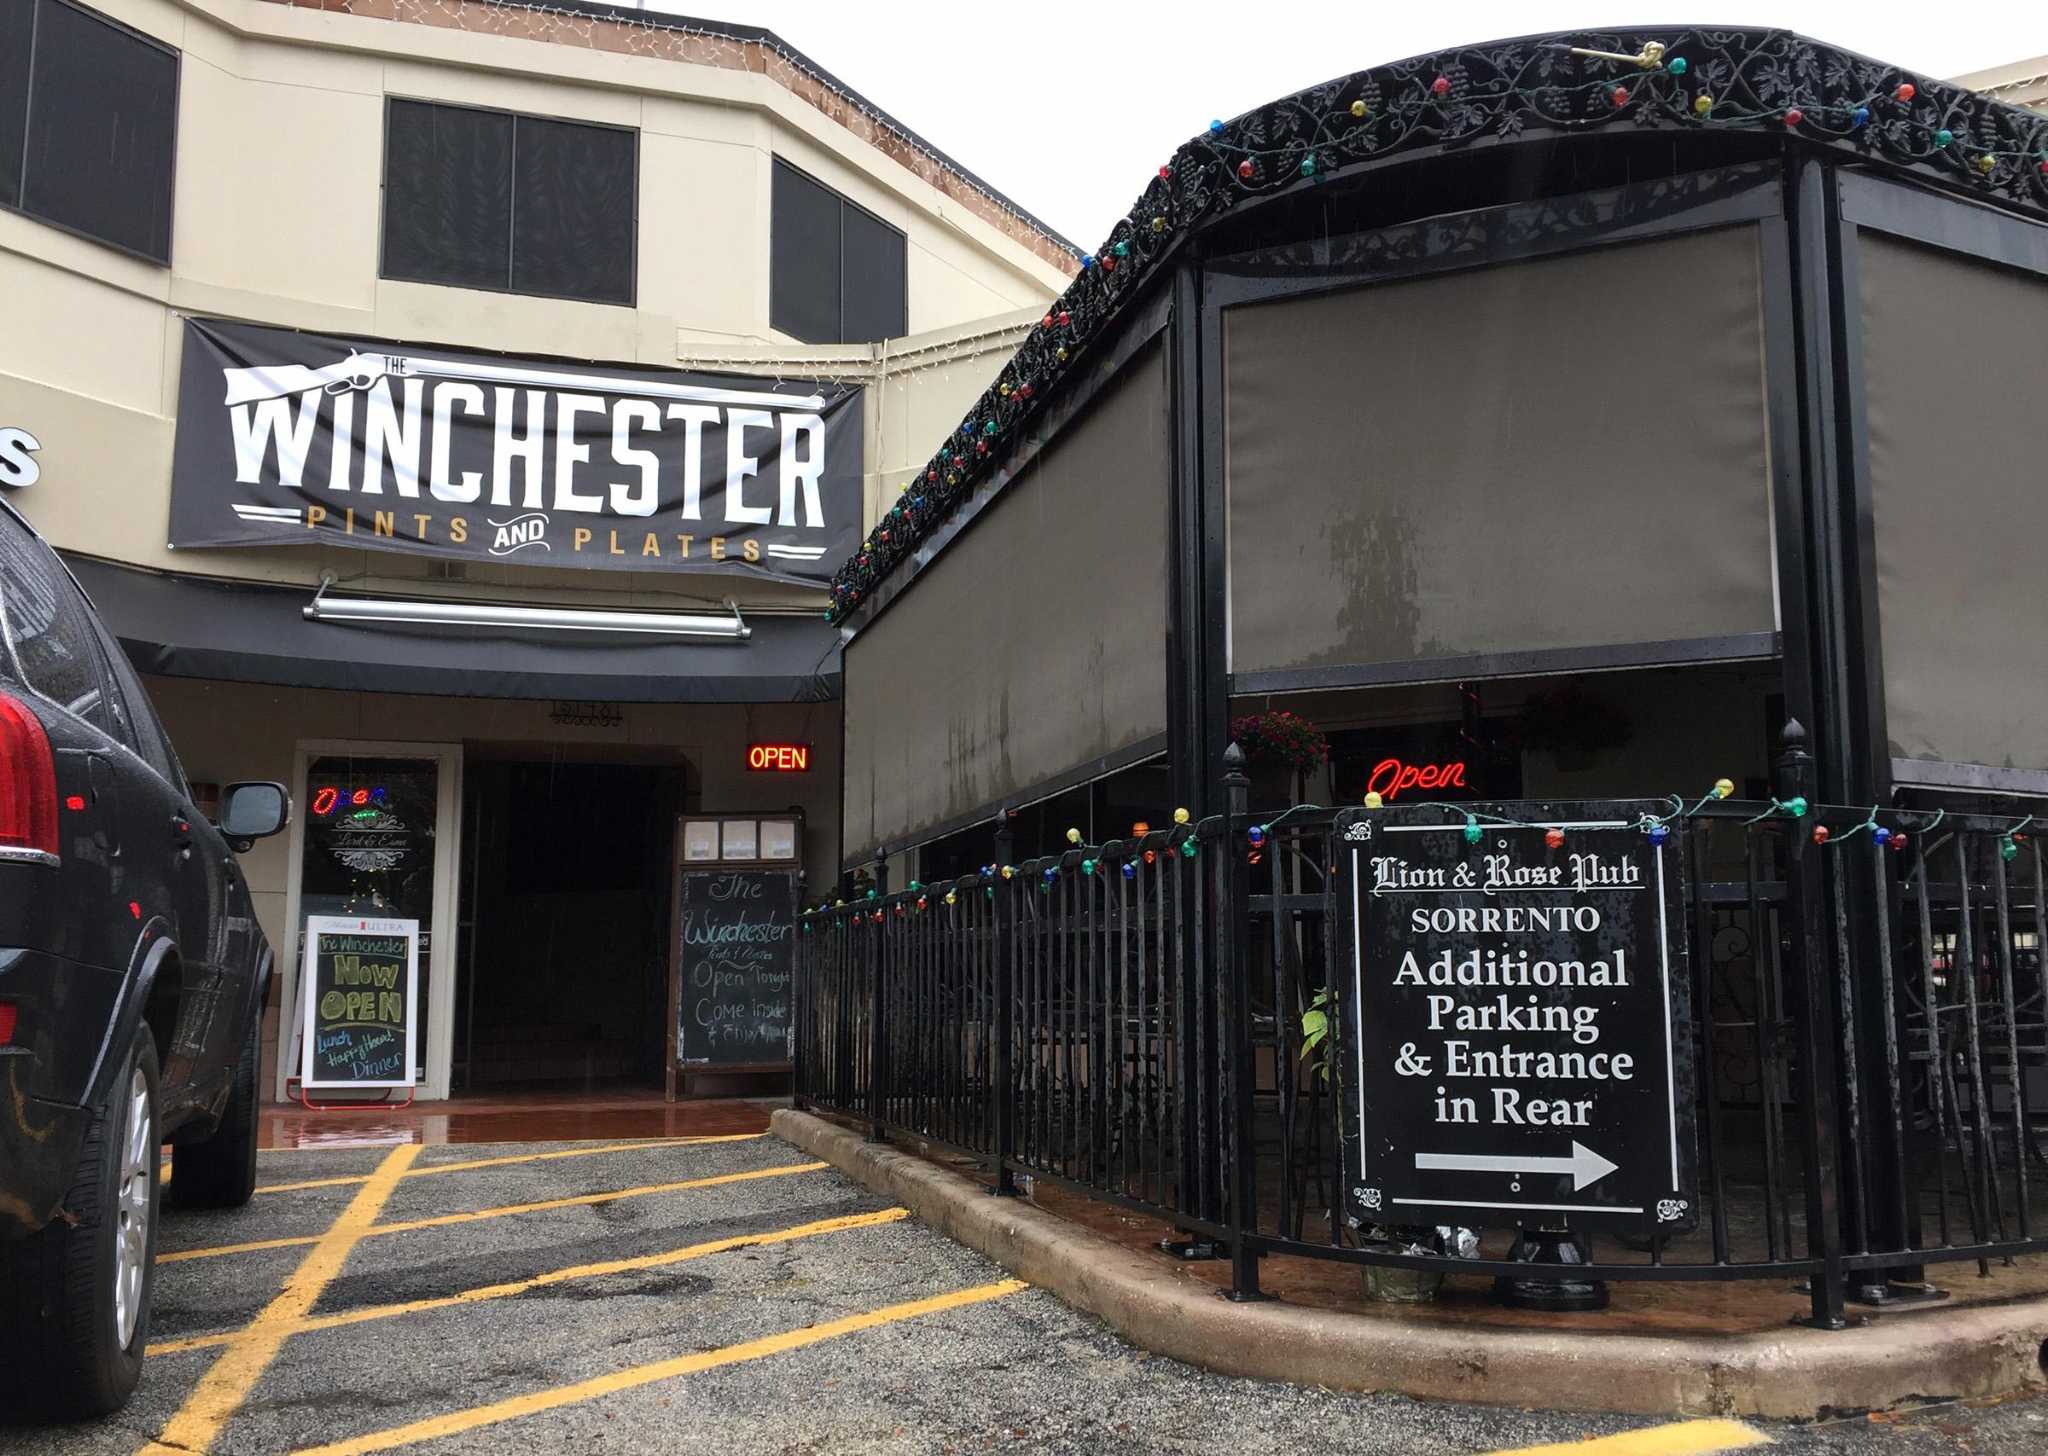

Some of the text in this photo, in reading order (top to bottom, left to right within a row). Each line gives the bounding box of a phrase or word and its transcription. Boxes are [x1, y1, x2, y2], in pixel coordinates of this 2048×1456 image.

[383, 354, 407, 376] THE
[227, 377, 827, 528] WINCHESTER
[307, 504, 761, 562] PINTS AND PLATES
[749, 746, 807, 769] OPEN
[1367, 758, 1466, 800] Open
[709, 873, 762, 901] The
[1369, 853, 1641, 897] Lion & Rose Pub
[1411, 906, 1601, 933] SORRENTO
[694, 960, 745, 998] Open
[1392, 949, 1630, 987] Additional
[320, 990, 402, 1023] OPEN
[1427, 995, 1600, 1046] Parking
[1394, 1040, 1634, 1080] & Entrance
[1435, 1086, 1593, 1126] in Rear
